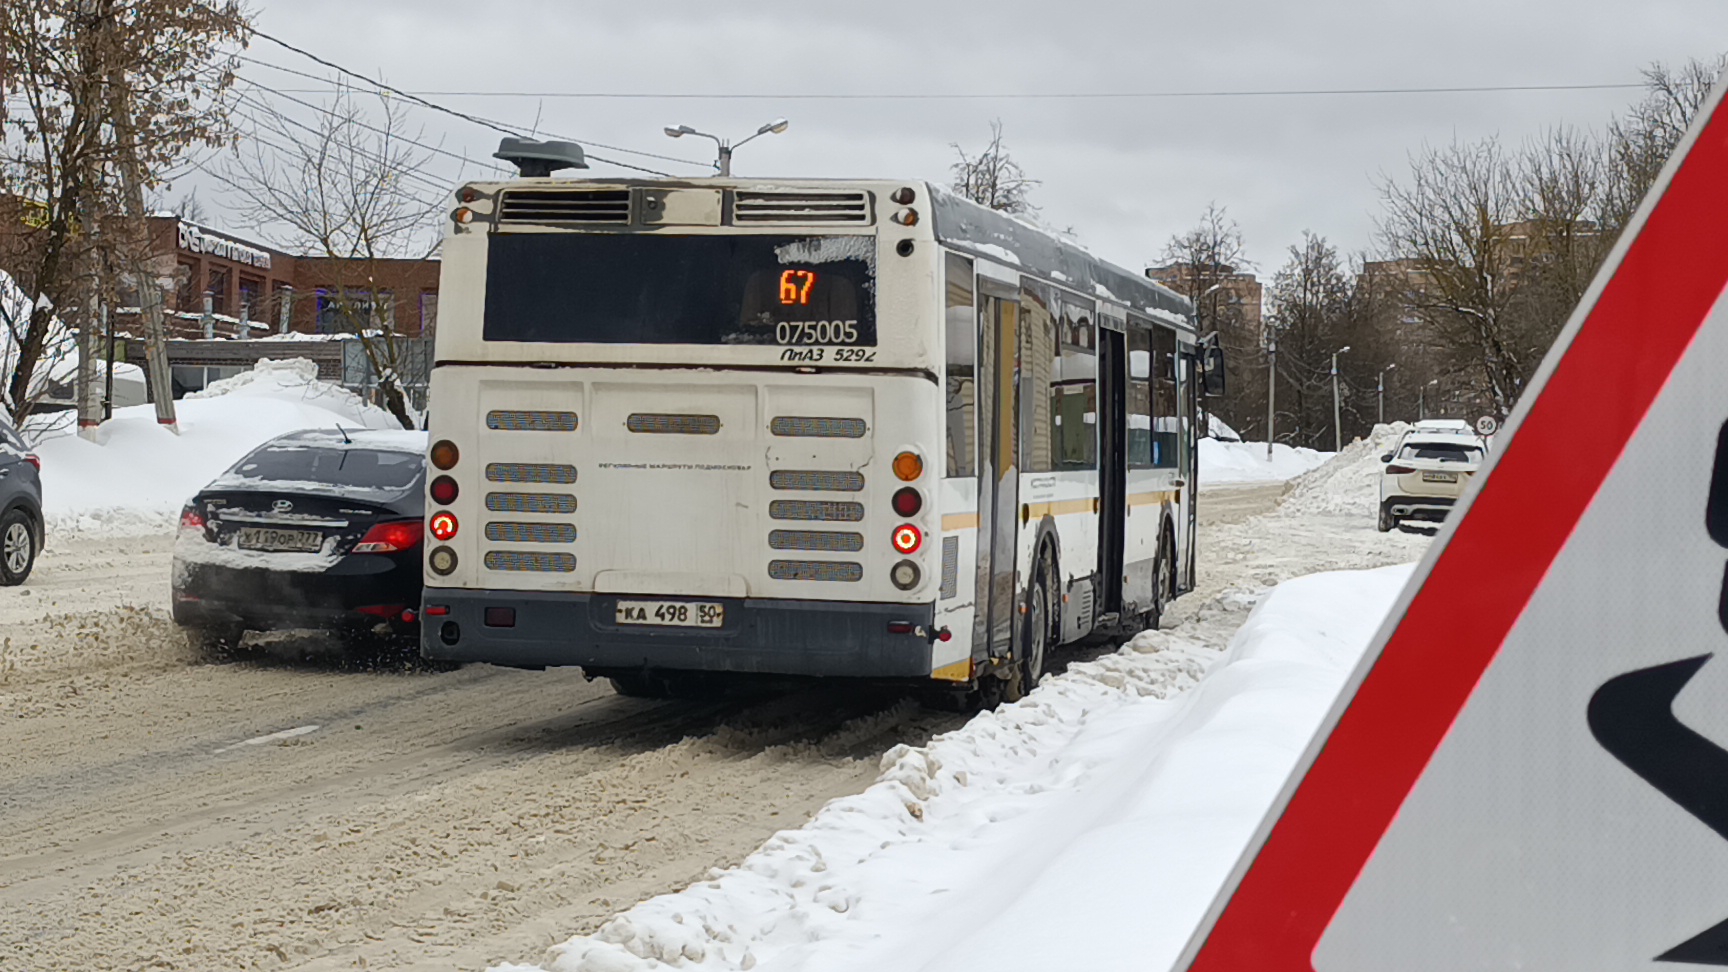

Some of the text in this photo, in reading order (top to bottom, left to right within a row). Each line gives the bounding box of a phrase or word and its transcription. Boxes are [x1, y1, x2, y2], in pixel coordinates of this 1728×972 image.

[780, 269, 816, 305] 67
[776, 320, 858, 344] 075005
[1479, 420, 1494, 431] 50
[624, 604, 716, 622] КА 498 50
